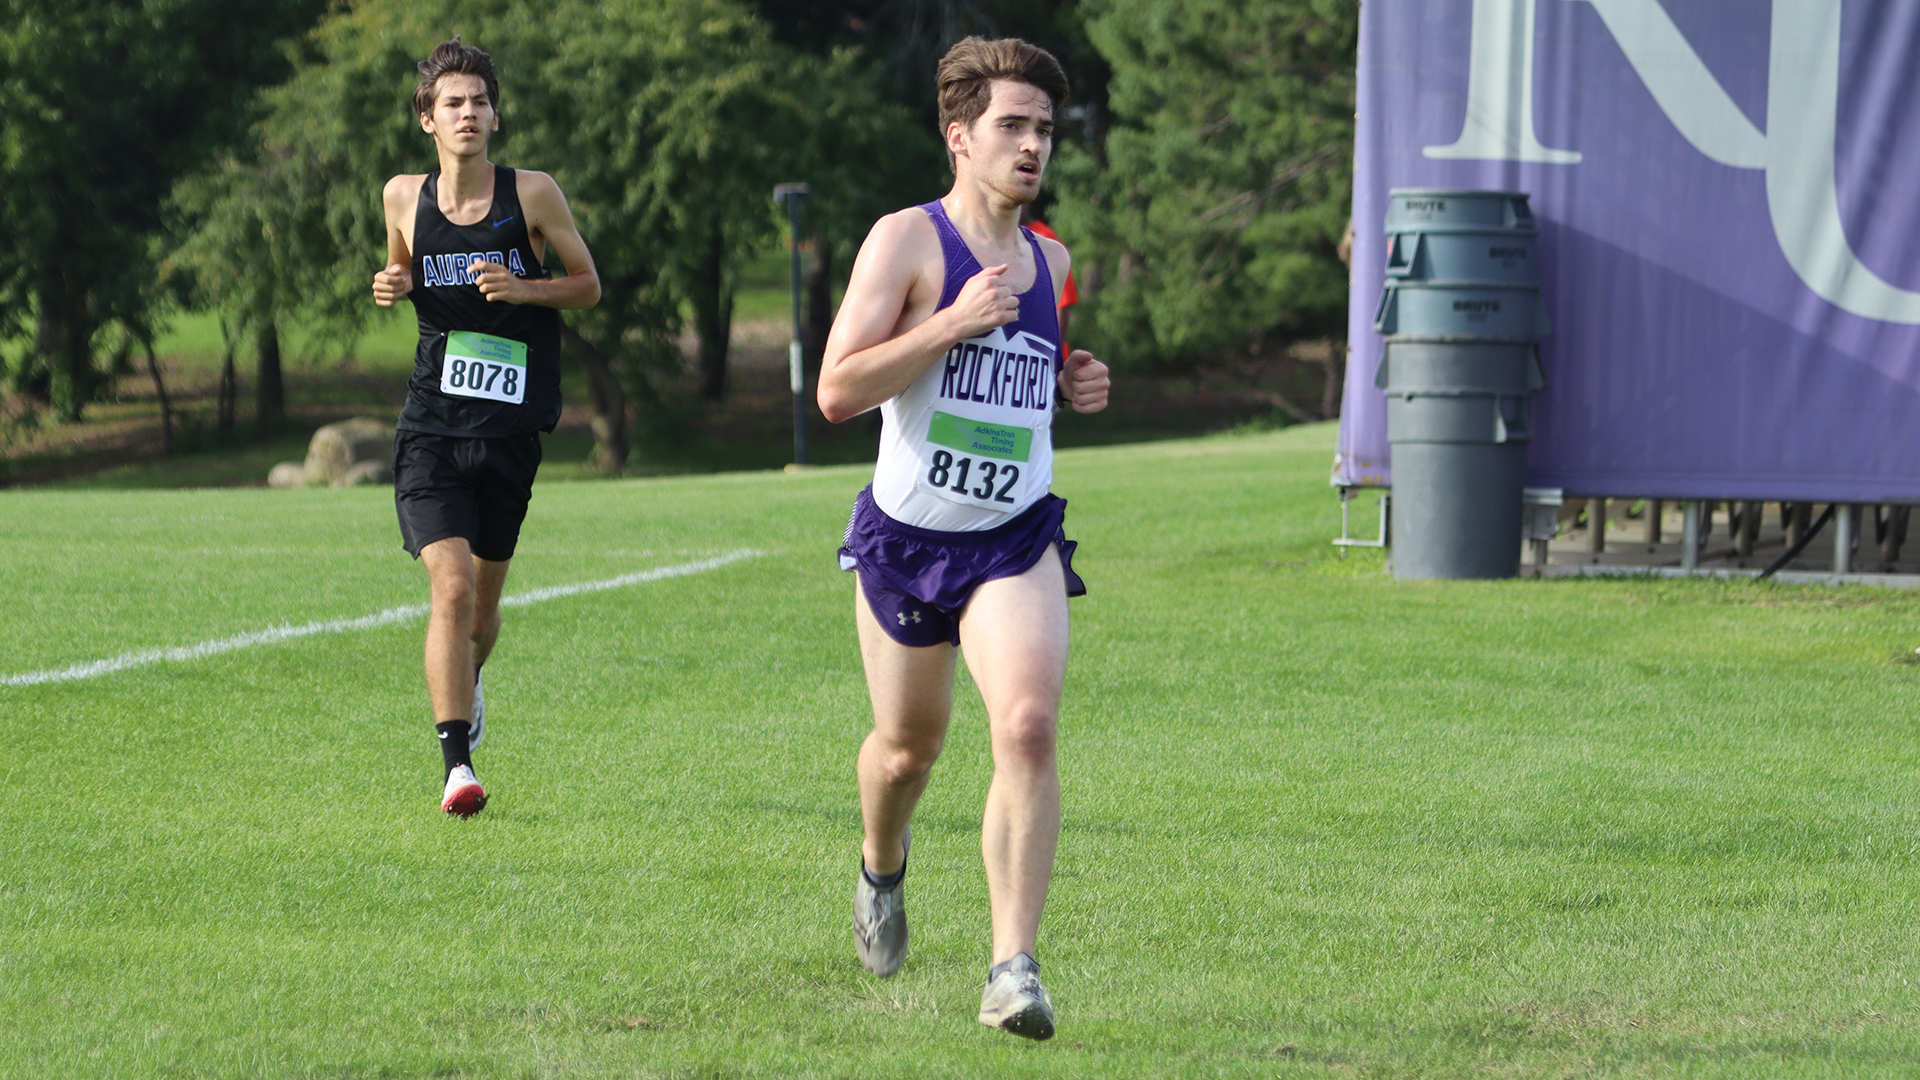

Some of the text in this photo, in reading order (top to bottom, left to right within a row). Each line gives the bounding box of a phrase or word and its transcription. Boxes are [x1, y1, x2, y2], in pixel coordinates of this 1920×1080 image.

[449, 359, 519, 397] 8078
[940, 342, 1050, 411] ROCKFORD
[971, 442, 1013, 454] Associates
[991, 437, 1015, 448] Timing
[927, 449, 1020, 504] 8132
